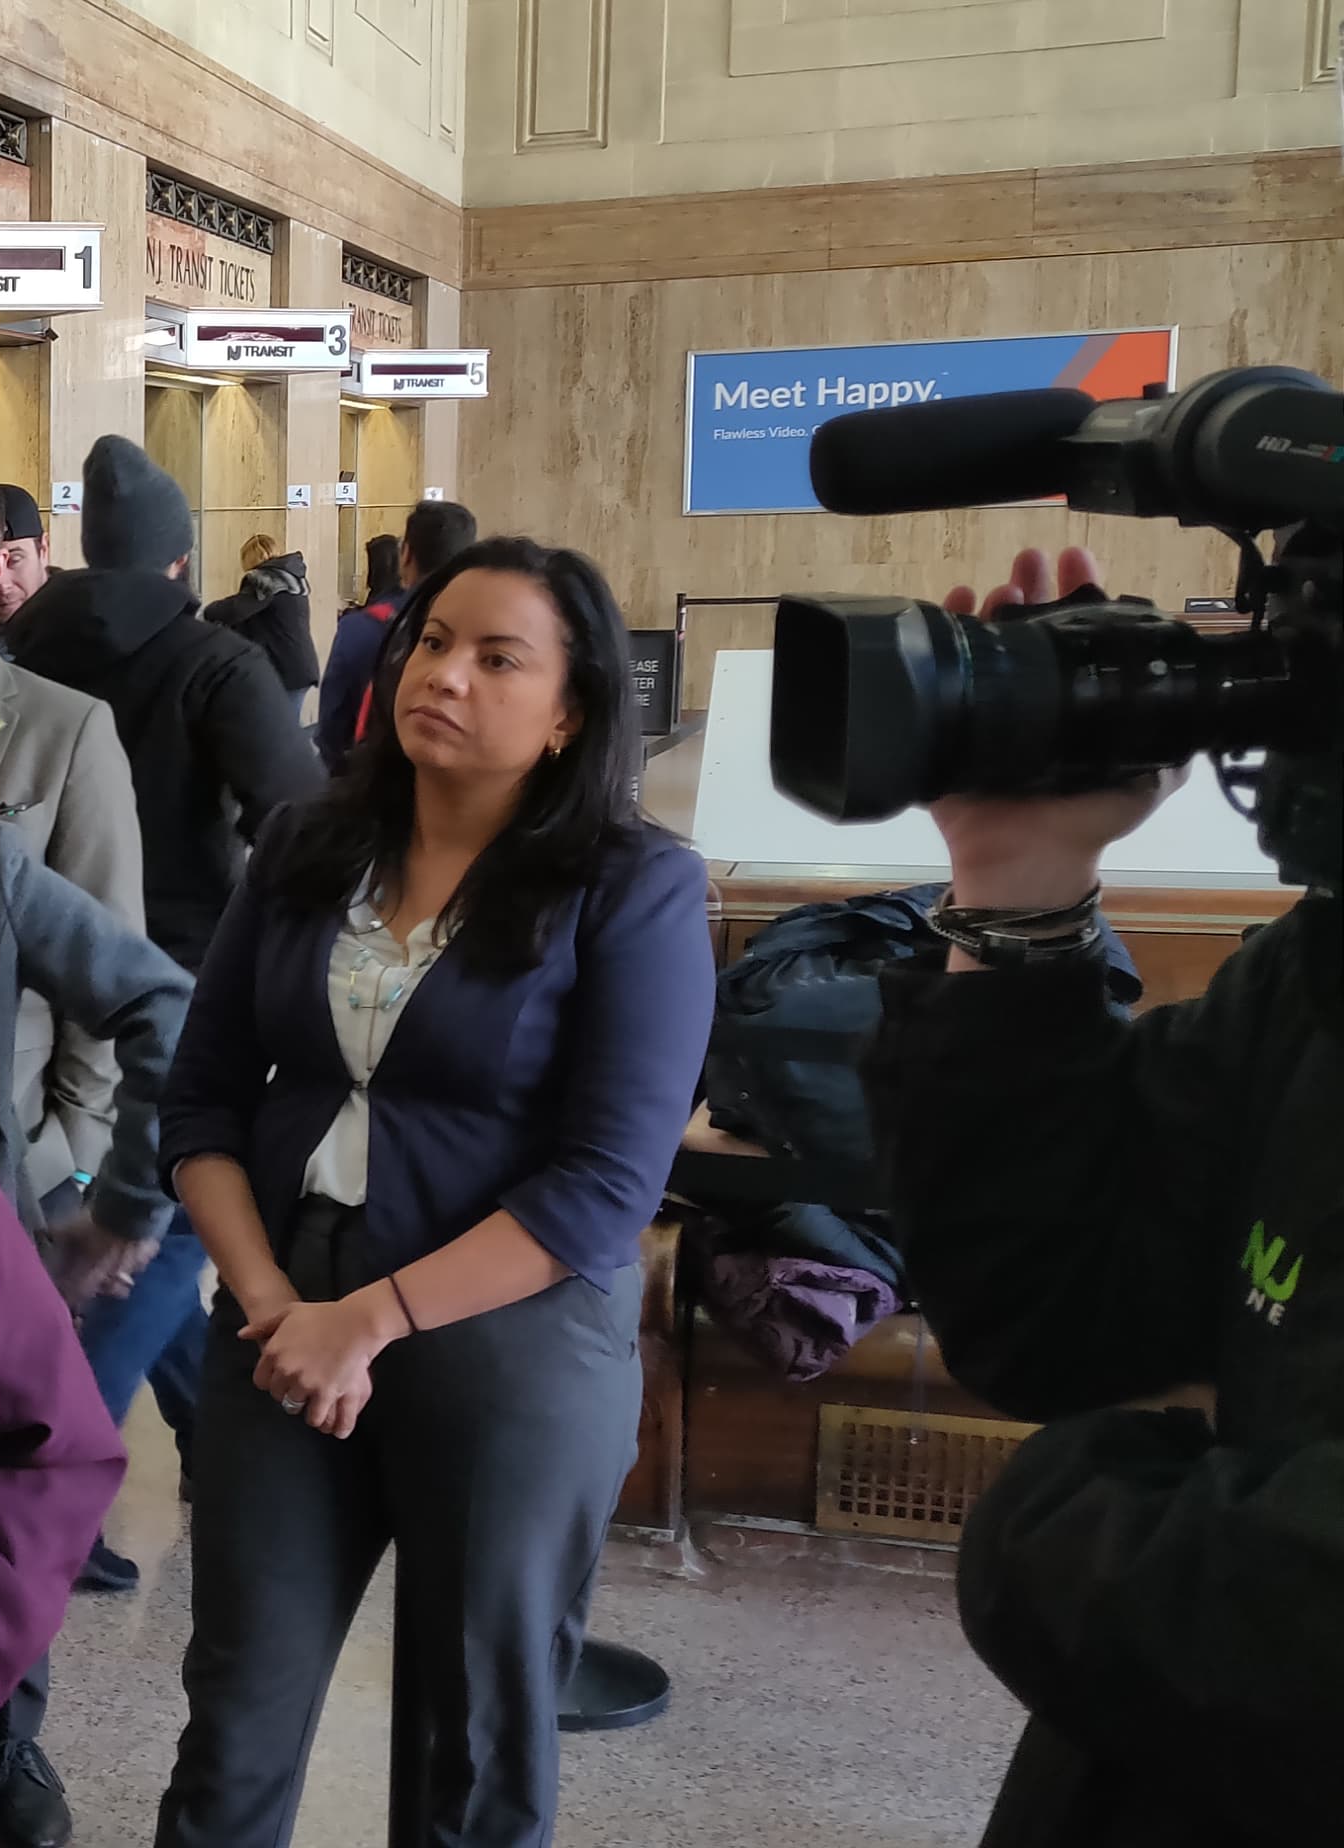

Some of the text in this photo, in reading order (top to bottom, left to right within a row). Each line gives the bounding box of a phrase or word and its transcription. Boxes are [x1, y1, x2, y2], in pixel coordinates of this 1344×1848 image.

[74, 246, 92, 288] 1
[146, 236, 255, 301] NJ TRANSIT TICKETS
[328, 325, 347, 355] 3
[245, 346, 295, 357] TRANSIT
[469, 363, 484, 385] 5
[407, 378, 445, 388] TRANSIT
[713, 380, 806, 410] Meet
[713, 428, 765, 440] Flawless
[768, 426, 808, 438] Video.
[62, 486, 71, 498] 2
[296, 488, 303, 498] 4
[342, 485, 349, 494] 5
[629, 660, 659, 672] EASE
[633, 677, 655, 689] TER
